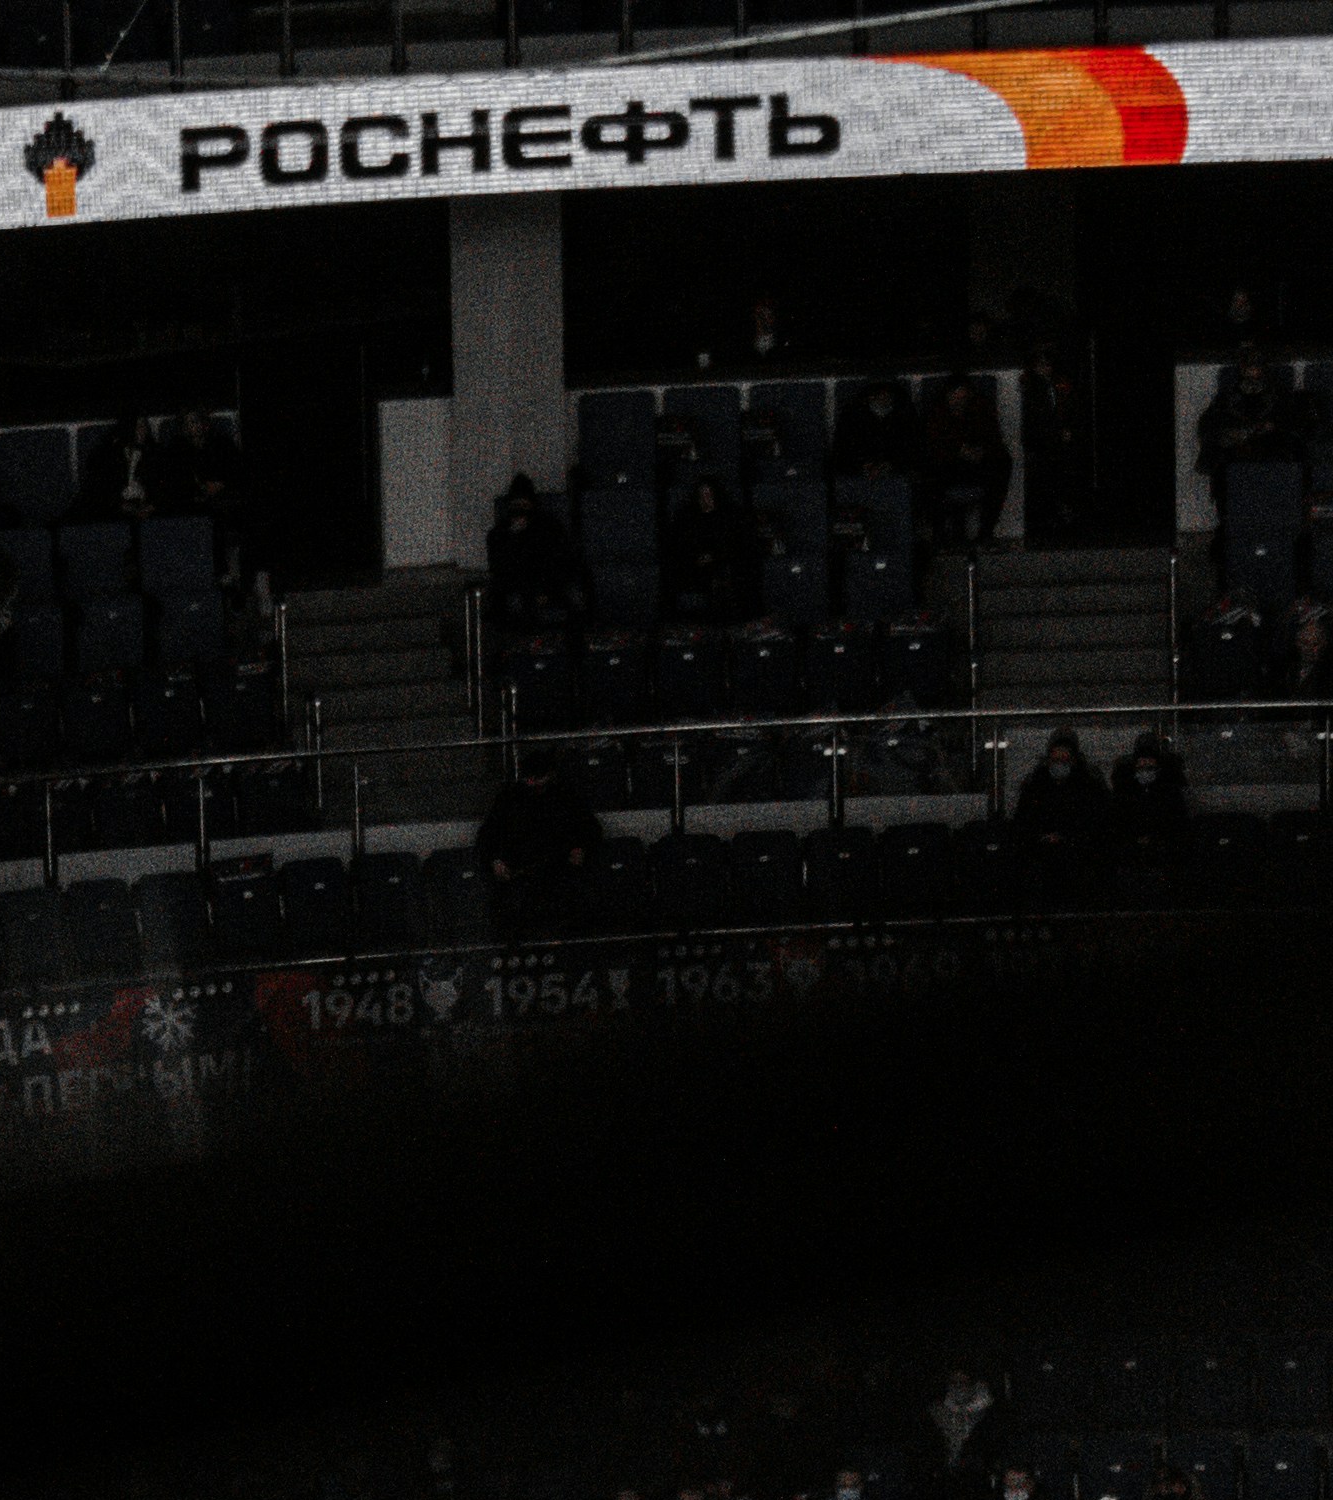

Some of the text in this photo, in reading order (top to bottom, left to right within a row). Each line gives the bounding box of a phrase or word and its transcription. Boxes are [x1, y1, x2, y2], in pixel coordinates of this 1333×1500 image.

[180, 93, 843, 194] РОСНЕФТЬ
[301, 983, 414, 1030] 1948
[484, 970, 599, 1016] 1954
